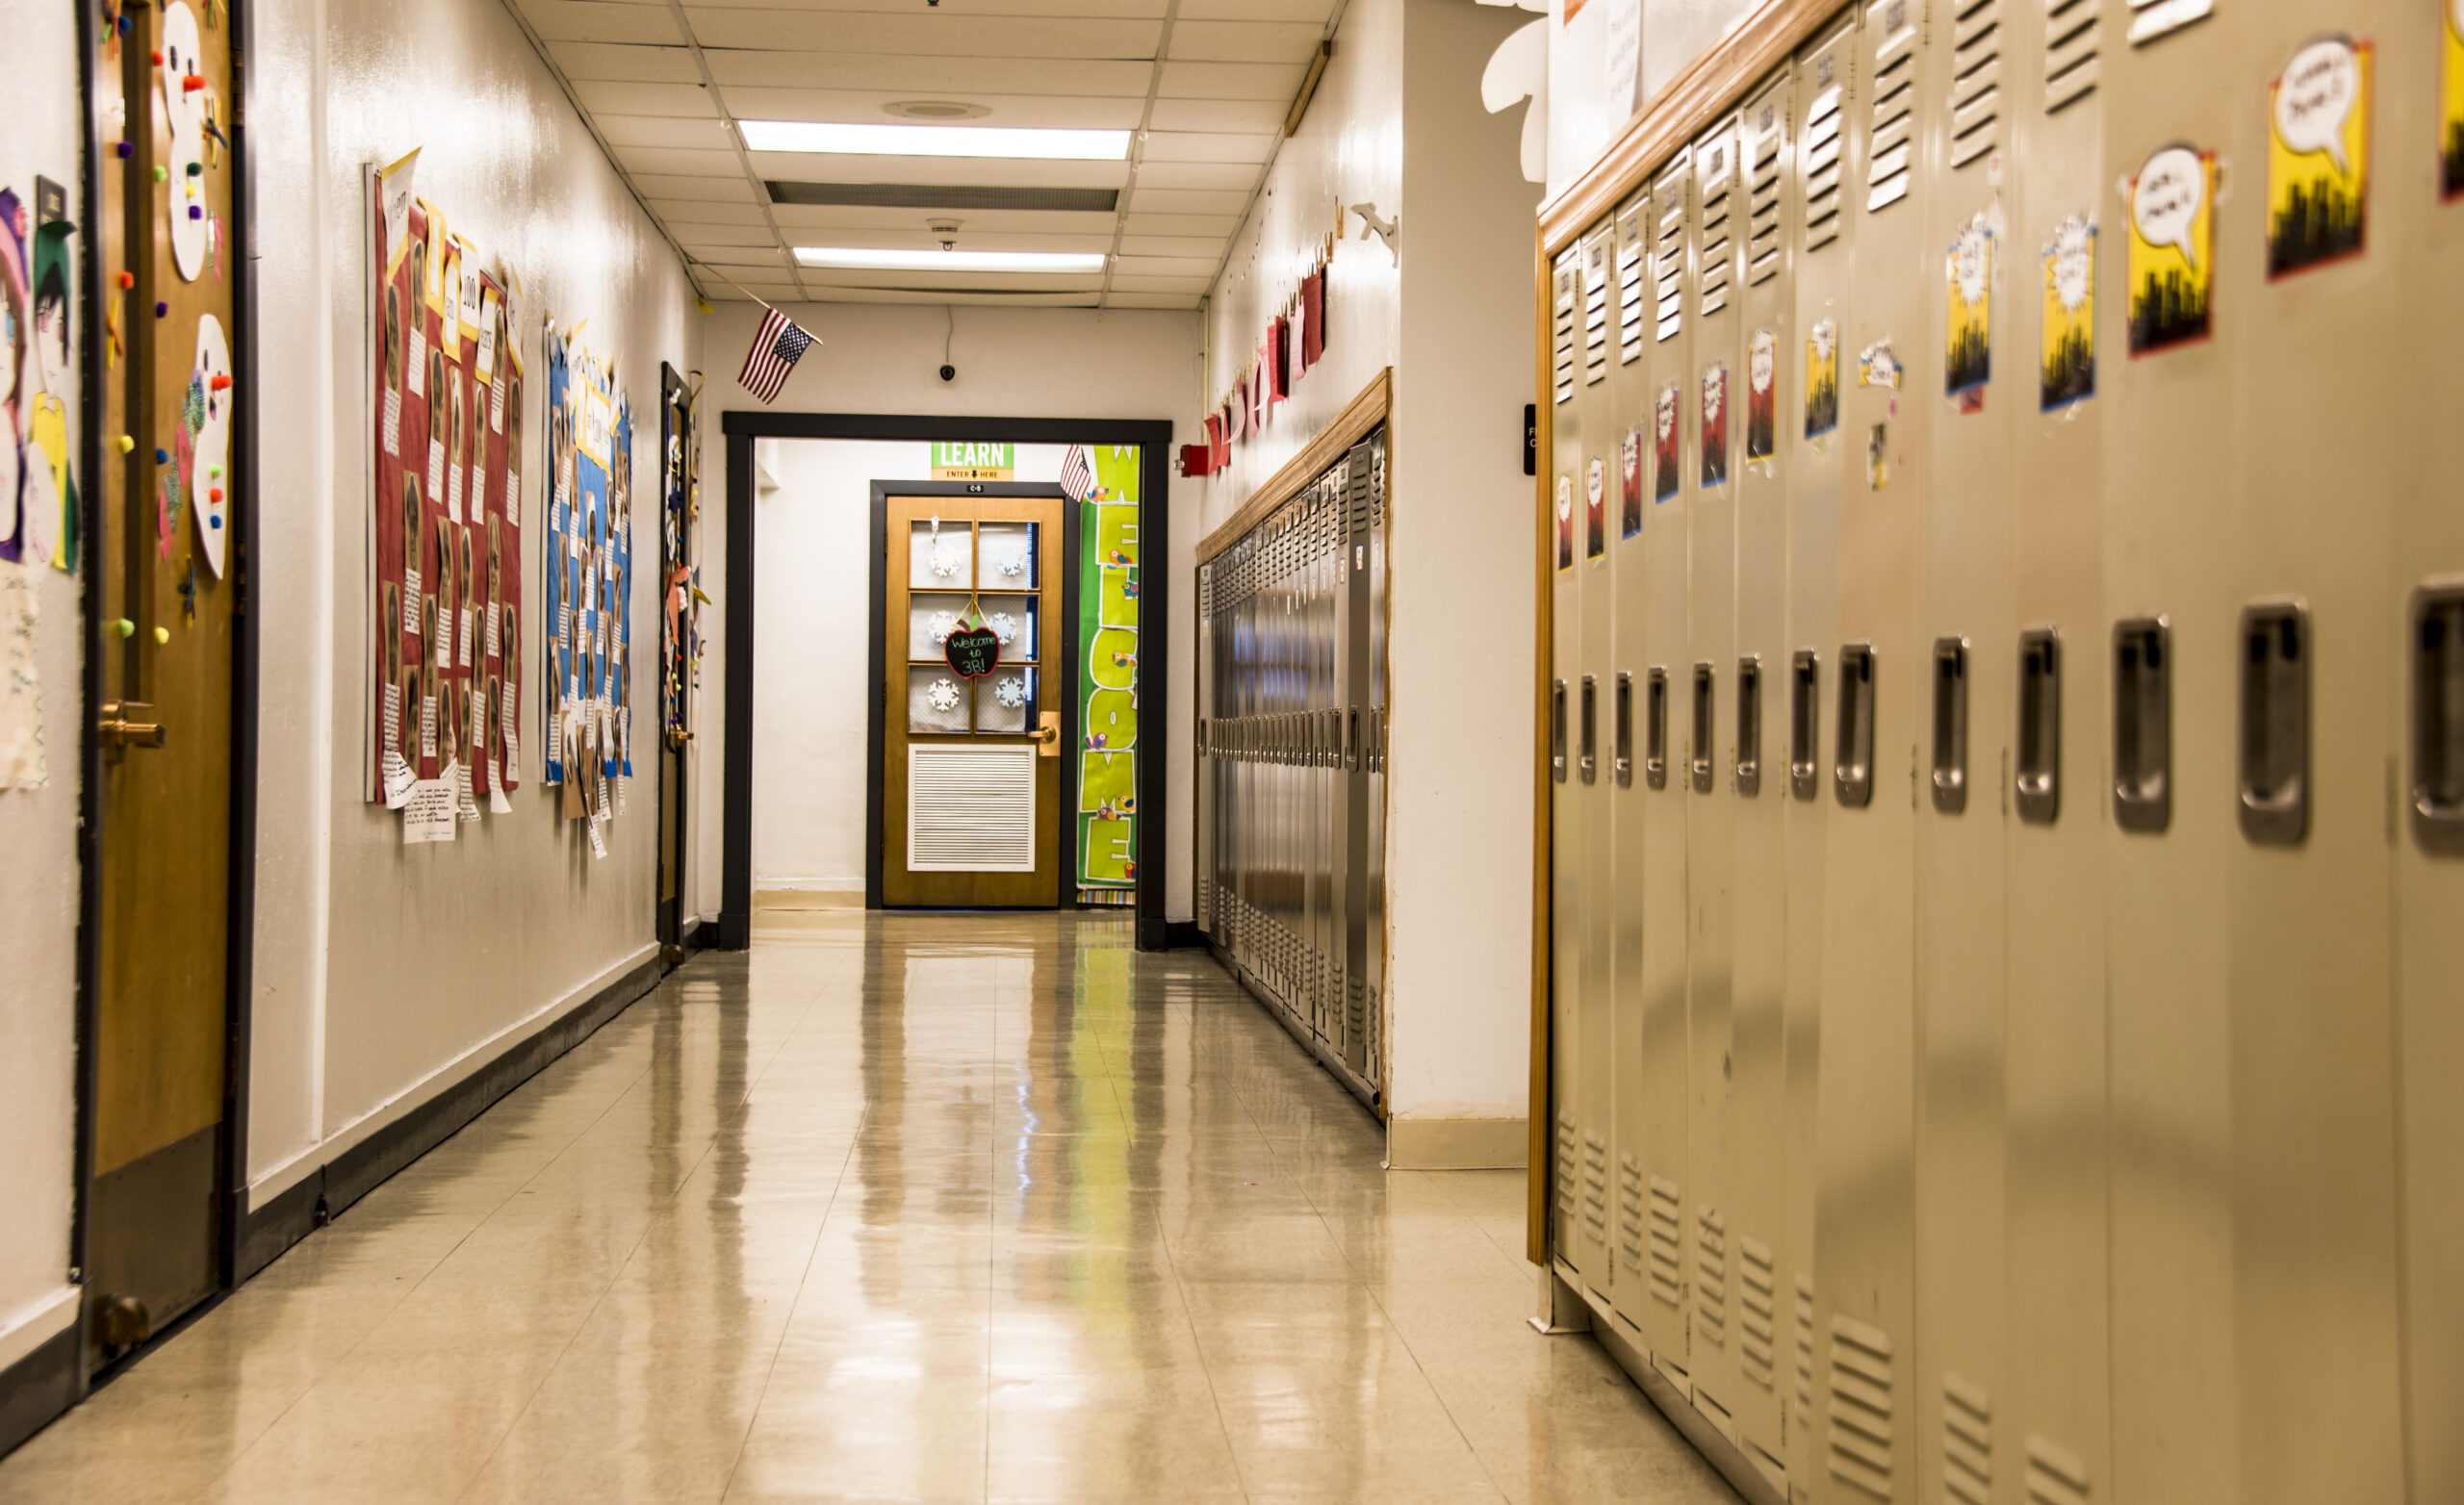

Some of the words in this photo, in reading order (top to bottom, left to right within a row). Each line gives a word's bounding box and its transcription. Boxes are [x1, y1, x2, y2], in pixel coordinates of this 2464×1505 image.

[464, 274, 476, 310] 100
[940, 443, 1004, 467] LEARN
[951, 636, 996, 649] Welcome
[969, 649, 982, 657] to
[962, 658, 986, 674] 3B!
